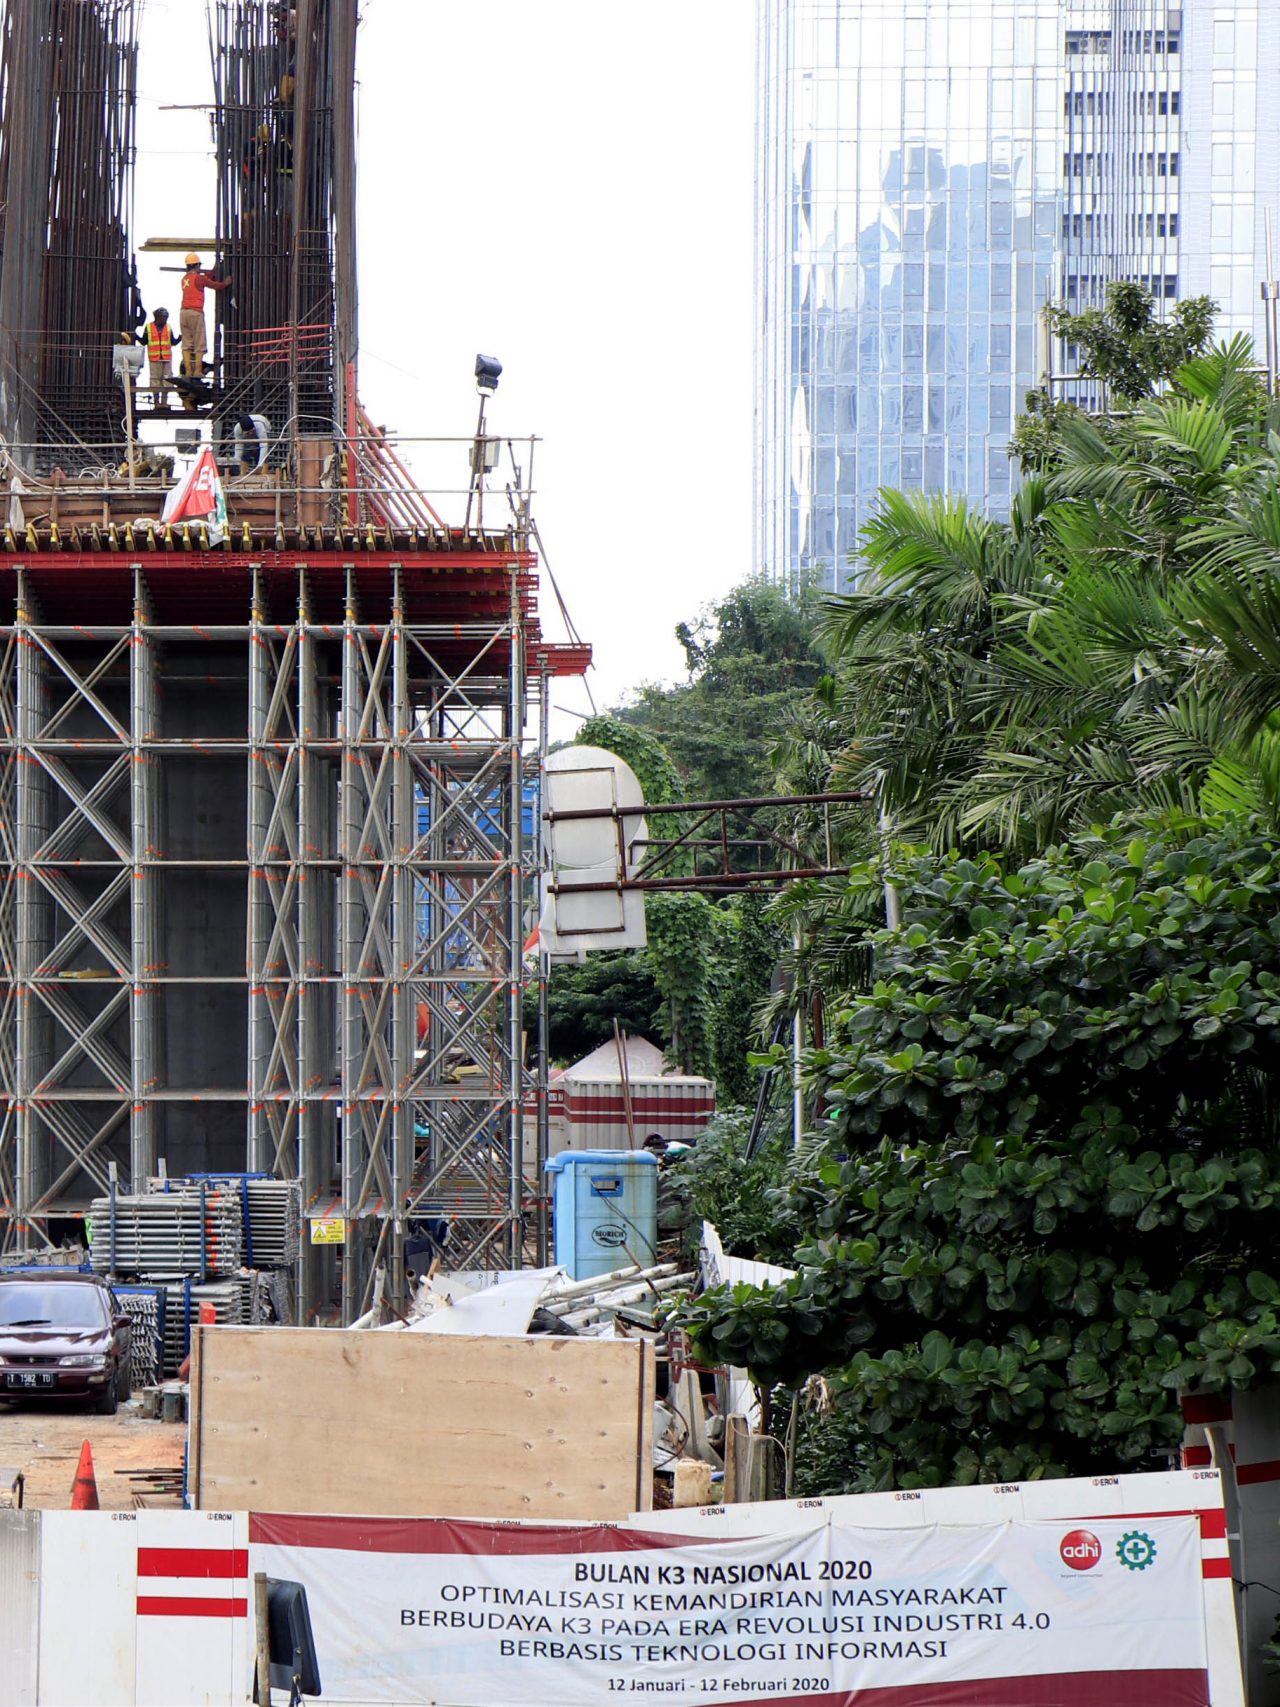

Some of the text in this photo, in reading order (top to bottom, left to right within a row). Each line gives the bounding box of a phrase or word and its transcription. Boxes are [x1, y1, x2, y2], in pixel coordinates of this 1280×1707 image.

[1061, 1542, 1100, 1559] adhi
[575, 1561, 872, 1584] BULAN K3 NASIONAL 2020
[440, 1584, 1007, 1611] OPTIMALISASI KEMANDIRIAN MASYARAKAT
[400, 1610, 1050, 1636] BERBUDAYA K3 PADA ERA REVOLUSI INDUSTRI 4.0
[500, 1639, 947, 1661] BERBASIS TEKNOLOGI INFORMASI
[609, 1679, 625, 1691] 12
[630, 1679, 684, 1691] Januari
[701, 1679, 718, 1691] 12
[724, 1678, 786, 1691] Februari
[792, 1678, 830, 1691] 2020
